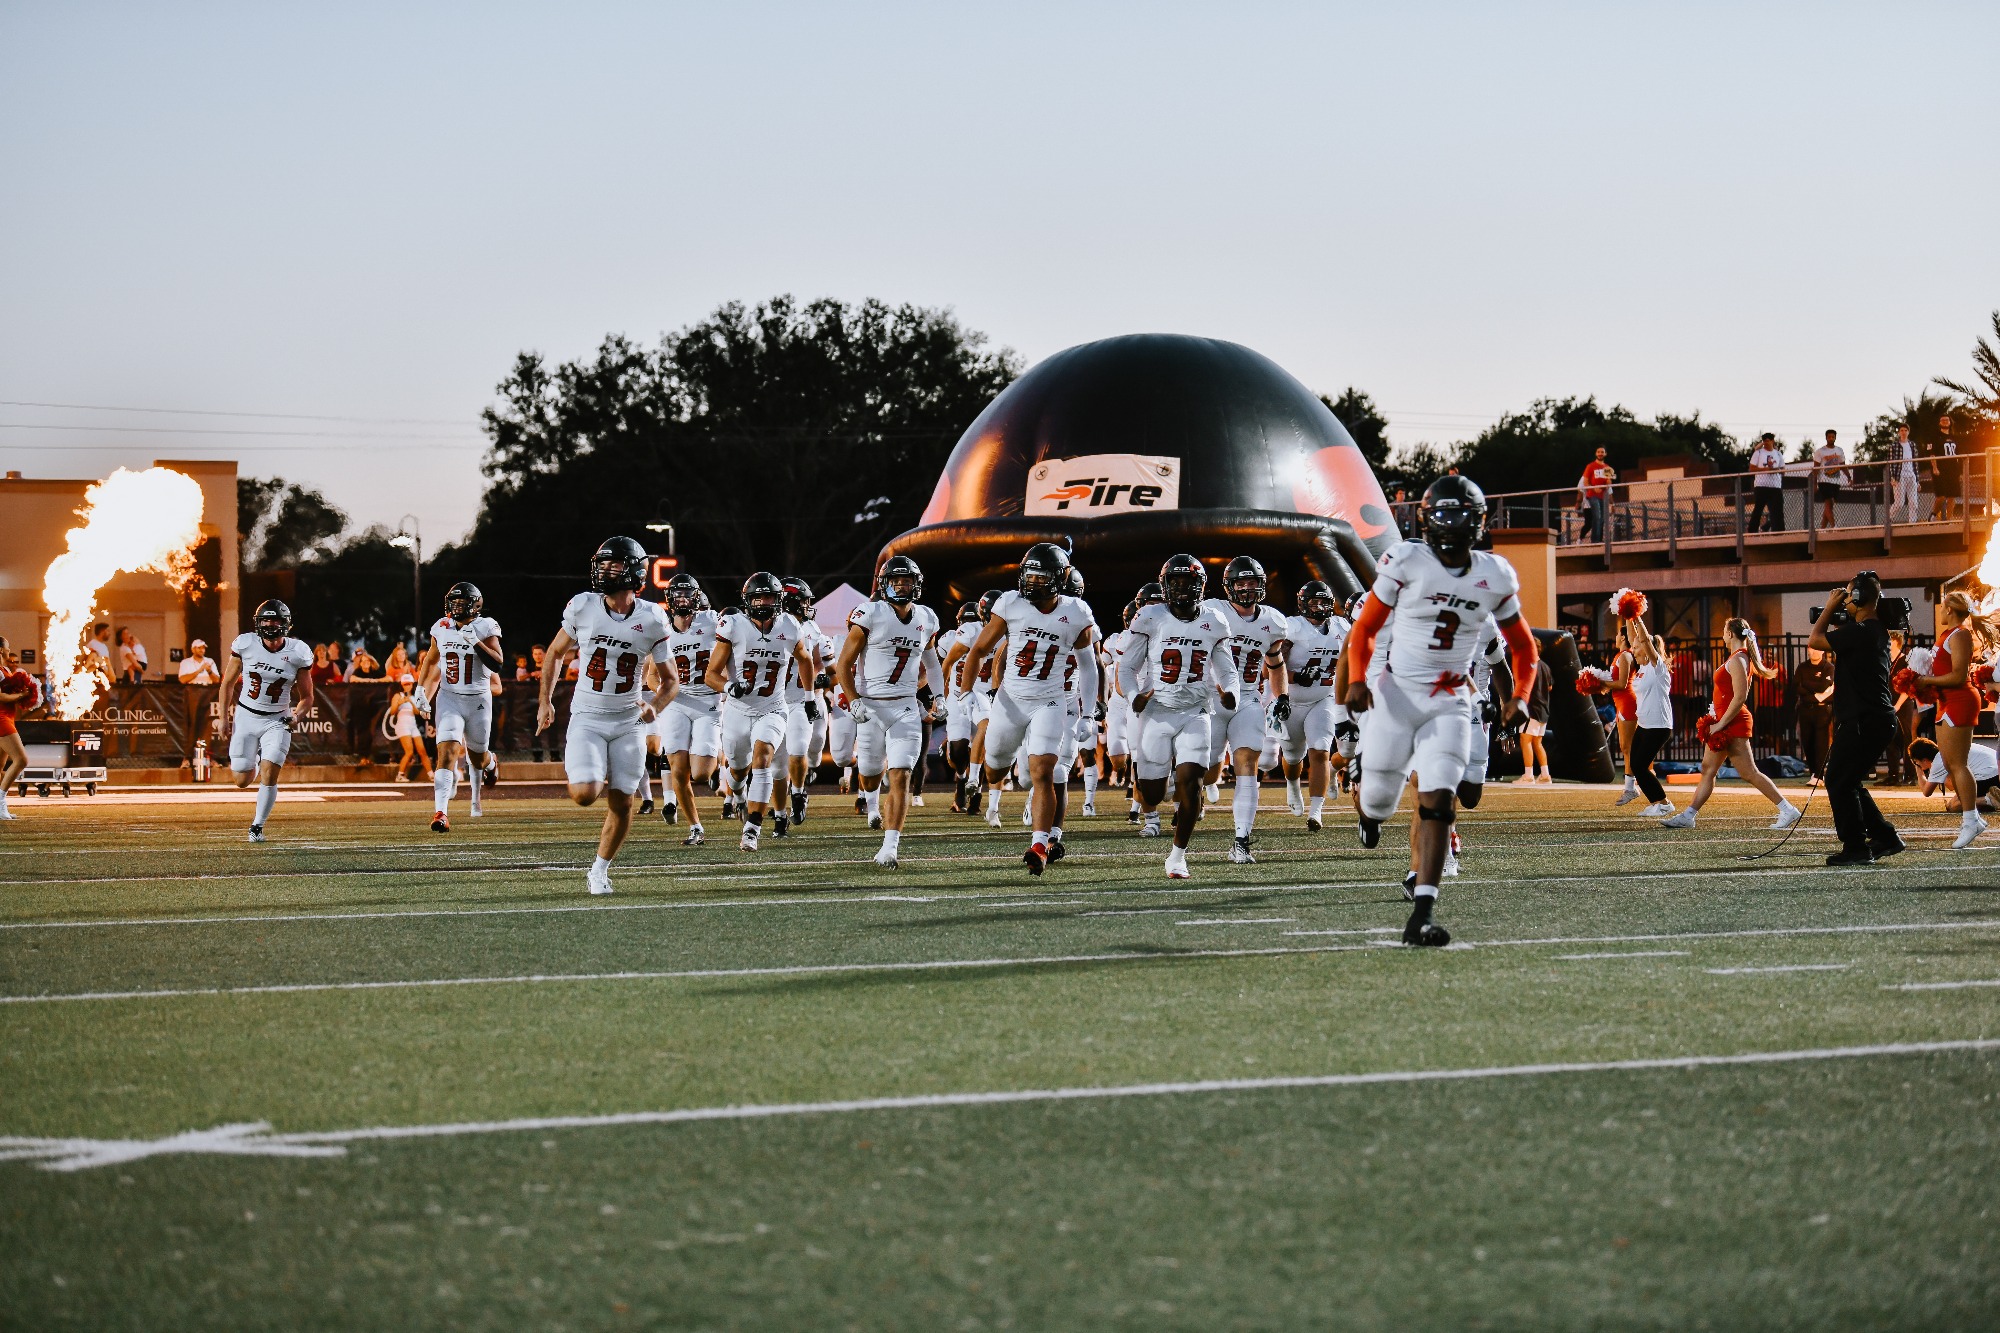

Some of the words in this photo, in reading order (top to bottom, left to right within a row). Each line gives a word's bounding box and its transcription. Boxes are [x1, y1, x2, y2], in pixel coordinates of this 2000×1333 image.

[1040, 477, 1163, 510] Fire
[1423, 592, 1480, 611] Fire
[1019, 626, 1060, 642] Fire
[1427, 609, 1461, 651] 3
[442, 641, 470, 651] Fire
[590, 634, 633, 650] Fire
[672, 642, 701, 655] Fire
[886, 636, 921, 648] Fire
[1161, 636, 1203, 647] Fire
[1229, 634, 1263, 648] Fire
[745, 648, 781, 659] Fire
[1308, 647, 1340, 656] Fire
[886, 647, 912, 685] 7
[1014, 639, 1060, 681] 41
[1160, 648, 1209, 685] 95
[250, 662, 285, 675] Fire
[586, 646, 639, 695] 49
[742, 660, 781, 698] 33
[247, 671, 289, 704] 34
[113, 727, 129, 736] Every
[131, 726, 167, 735] Generation
[75, 738, 101, 750] Fire
